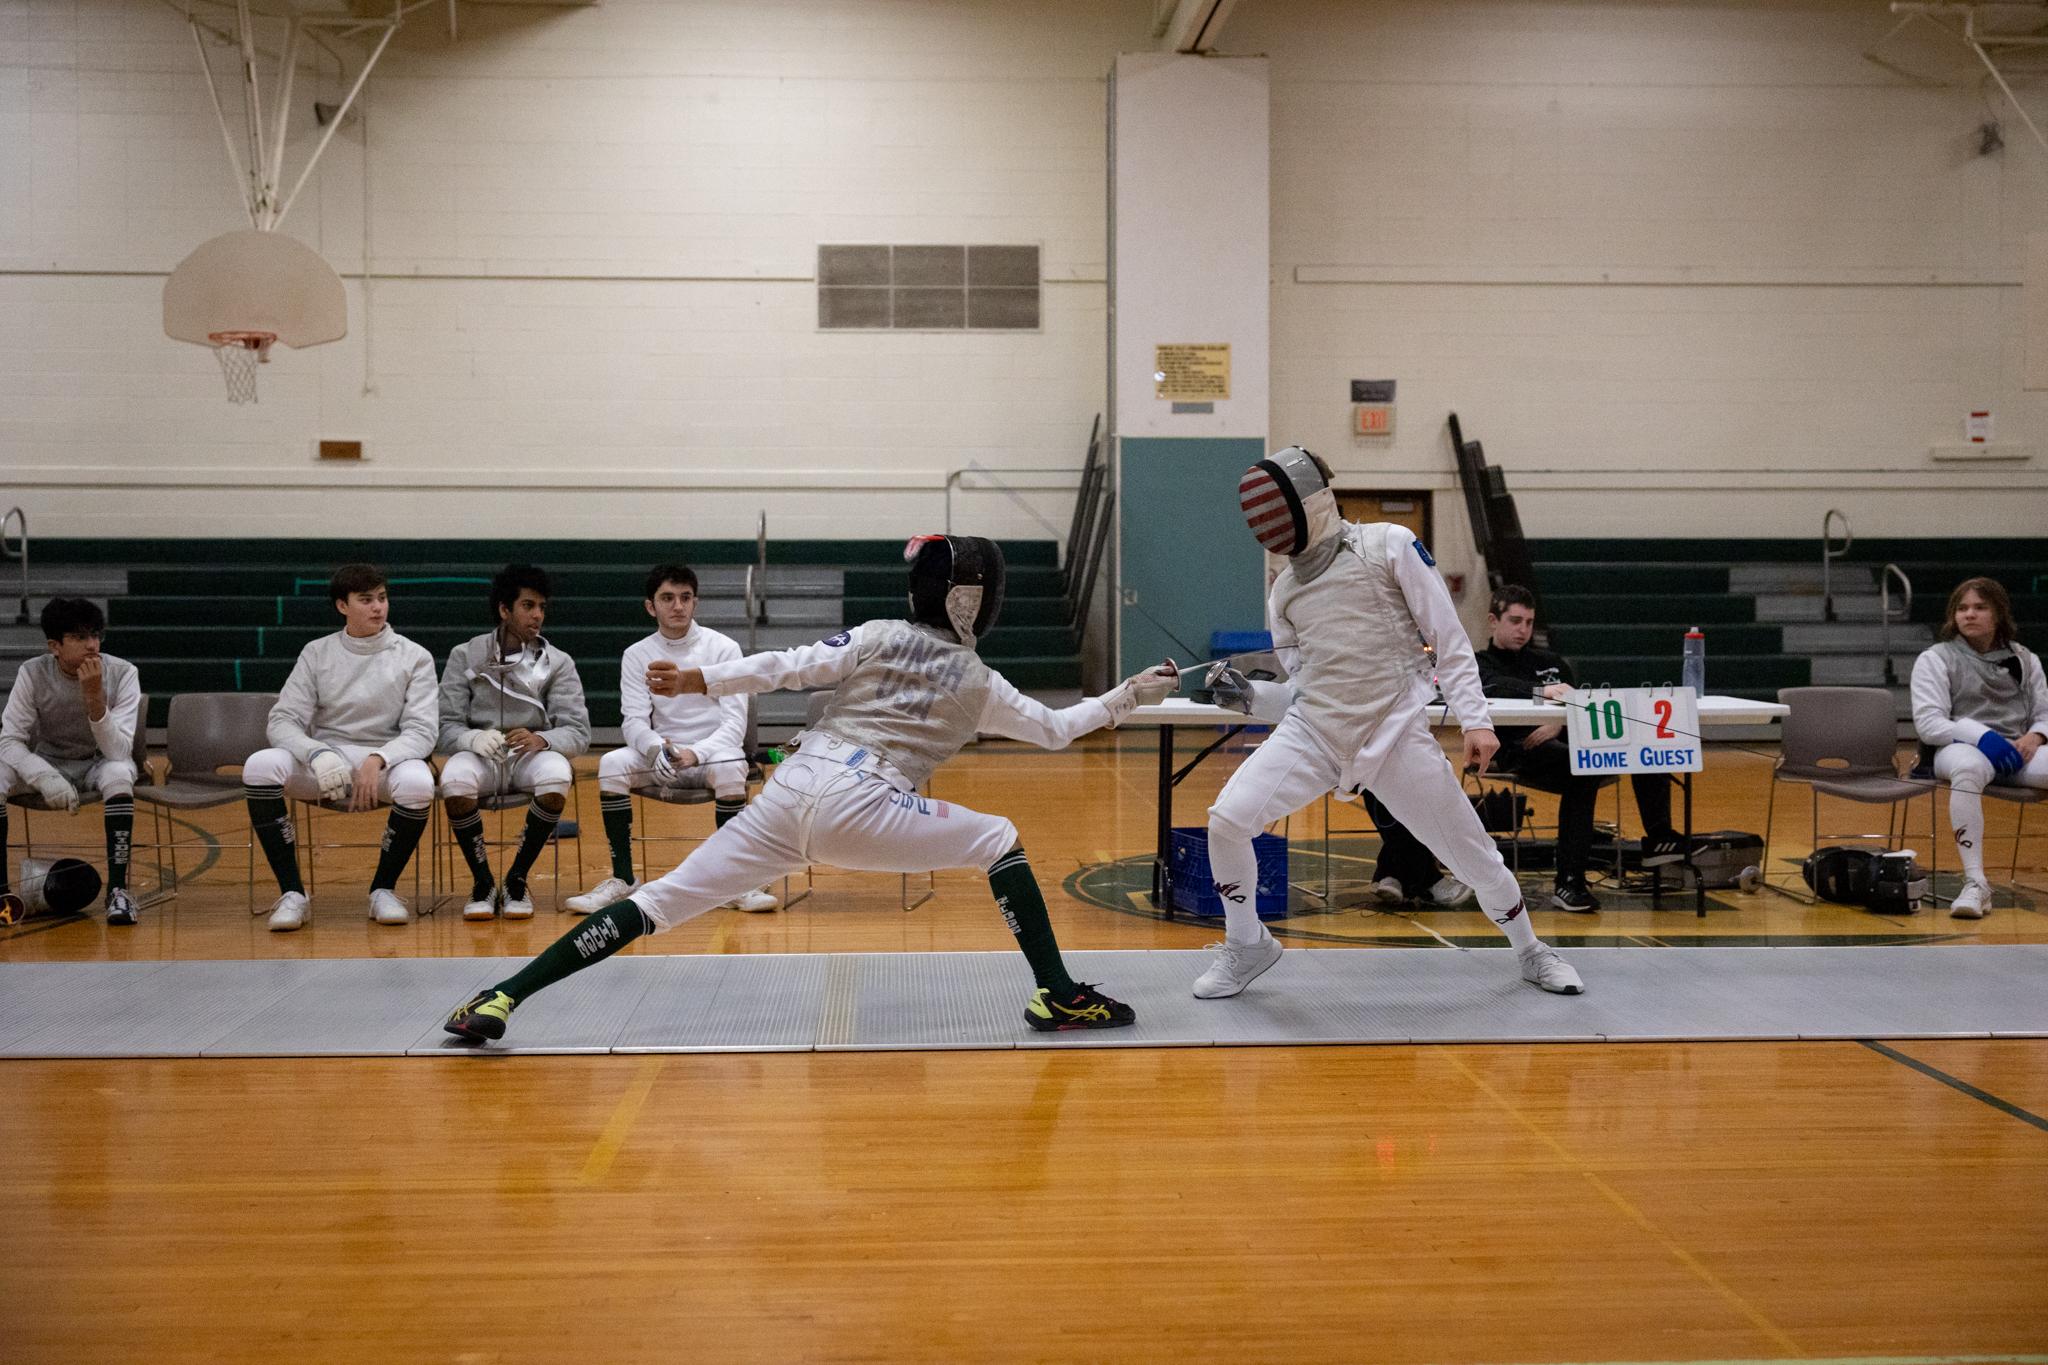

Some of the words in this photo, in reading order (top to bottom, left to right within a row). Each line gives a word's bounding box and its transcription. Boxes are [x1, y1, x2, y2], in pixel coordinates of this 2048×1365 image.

[881, 629, 969, 692] SINGH
[876, 668, 936, 721] USA
[1585, 700, 1624, 740] 10
[1654, 700, 1675, 739] 2
[573, 914, 620, 959] RIDGE
